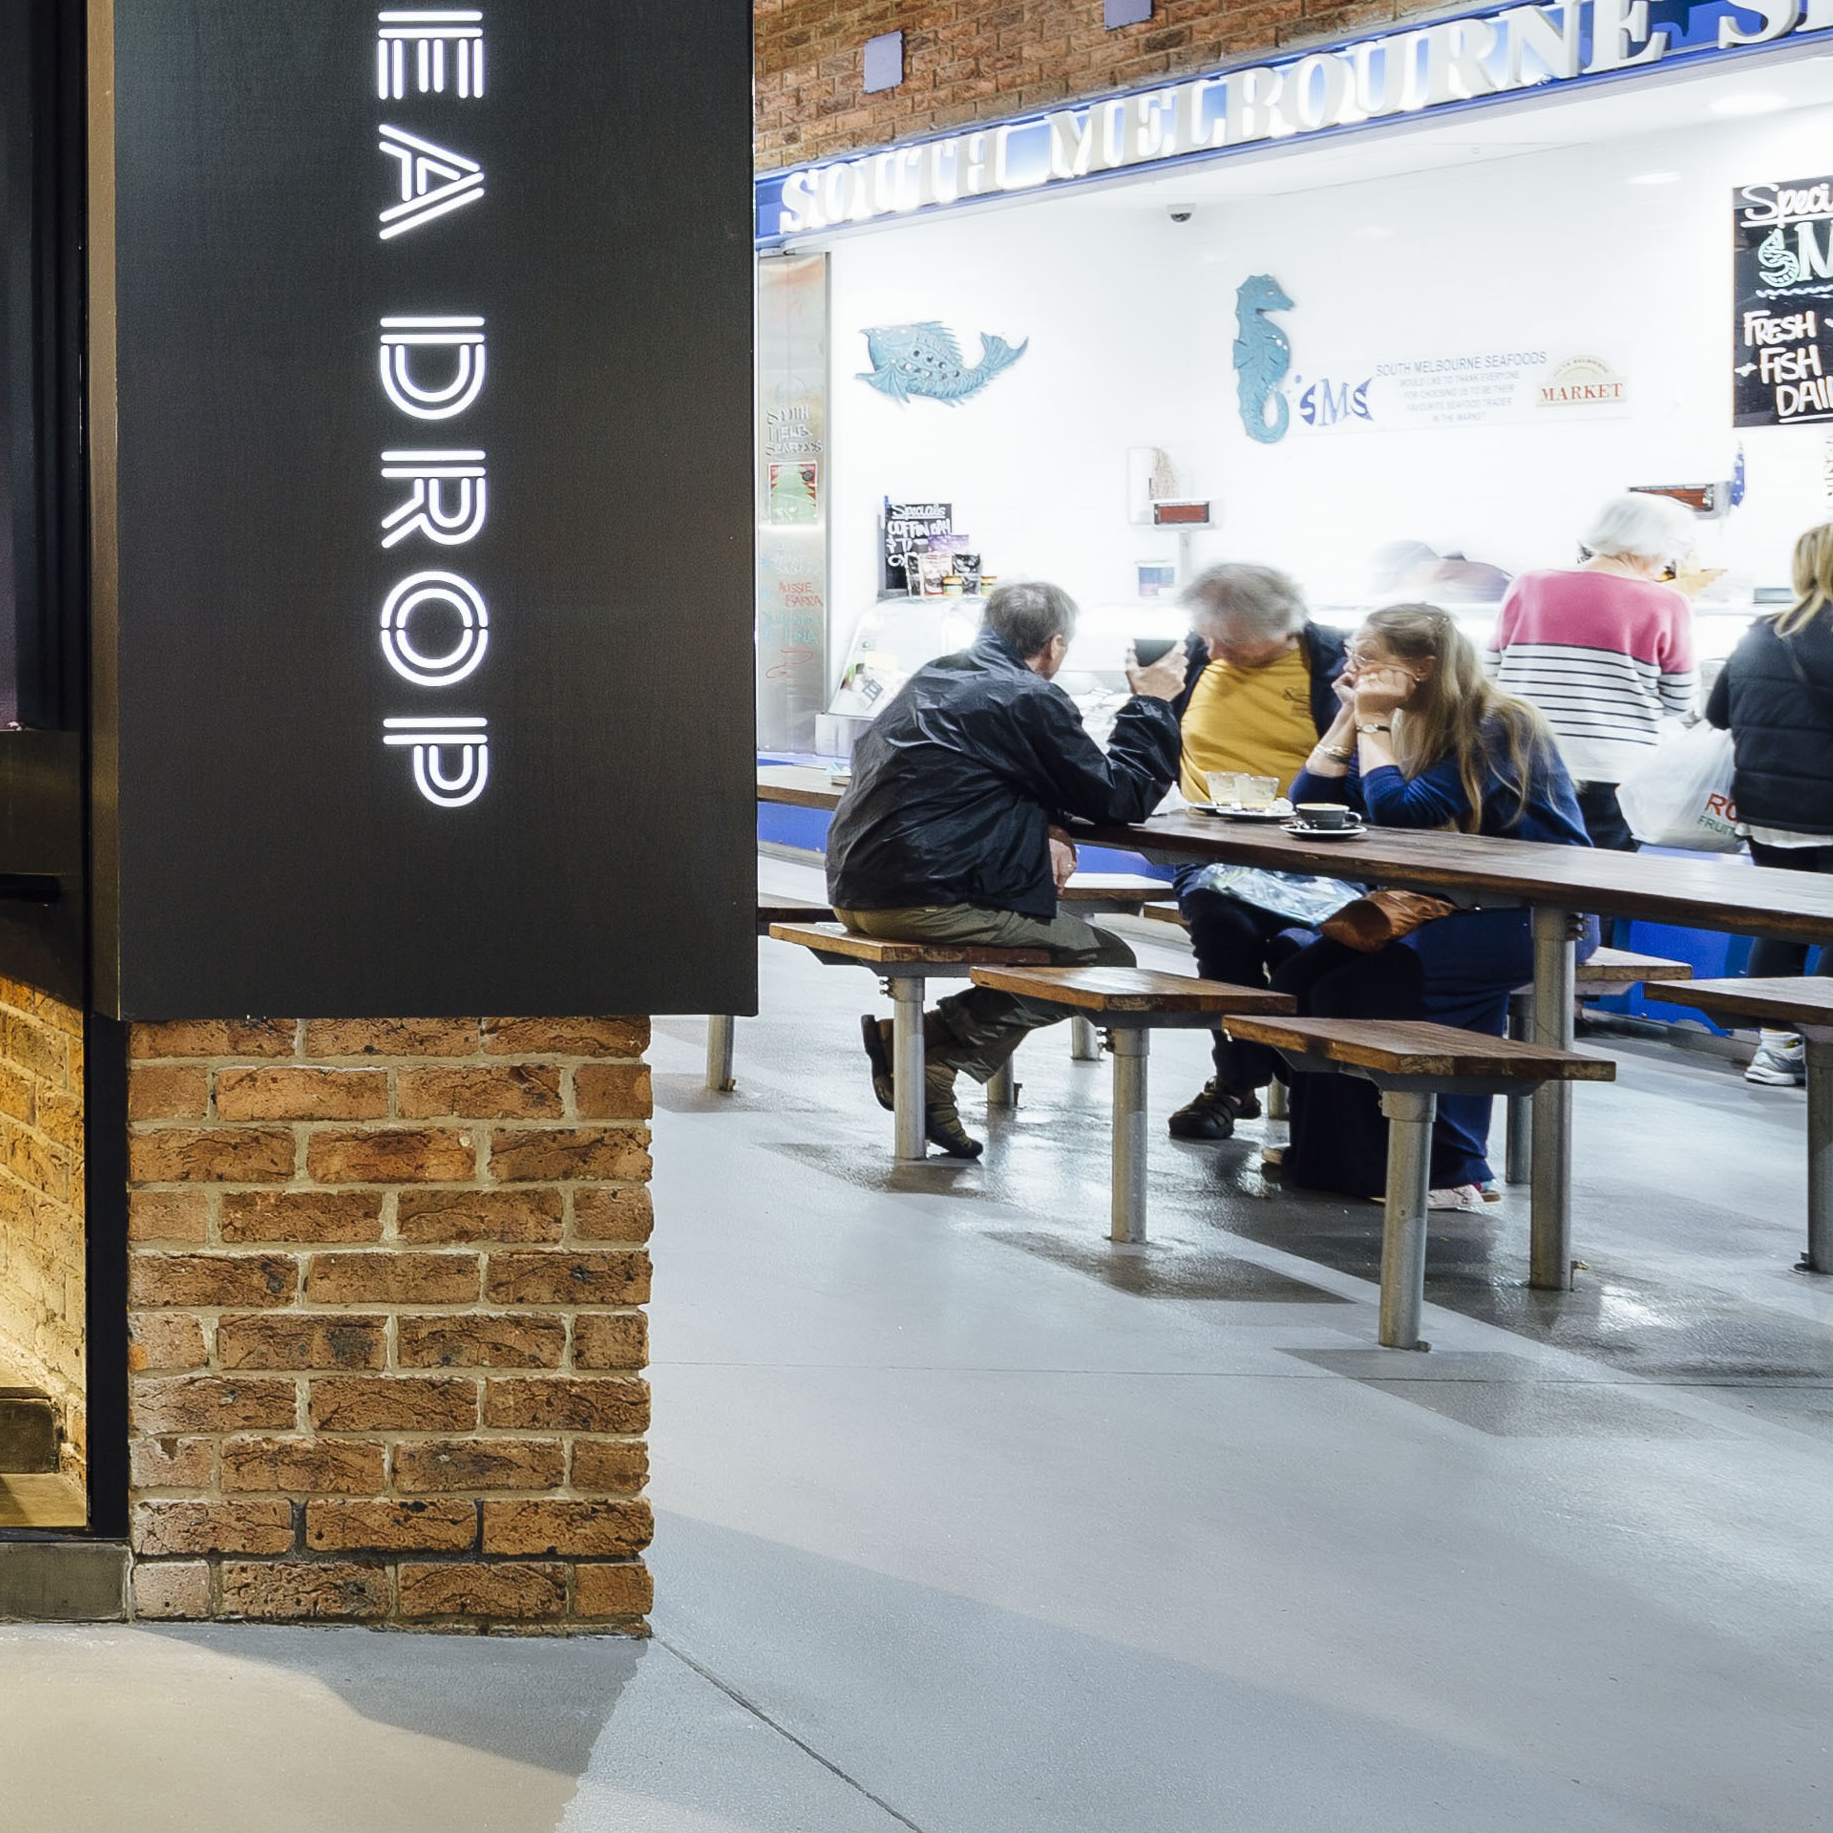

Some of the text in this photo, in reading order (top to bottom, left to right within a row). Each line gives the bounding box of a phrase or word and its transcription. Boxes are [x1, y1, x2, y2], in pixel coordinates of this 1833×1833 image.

[779, 121, 1010, 234] SOUTH
[1743, 310, 1818, 347] FRESH
[1375, 351, 1547, 377] SOUTH MELBOURNE SEAFOODS
[1759, 344, 1823, 386] FISH
[1541, 382, 1623, 402] MARKET
[379, 315, 488, 808] DROP
